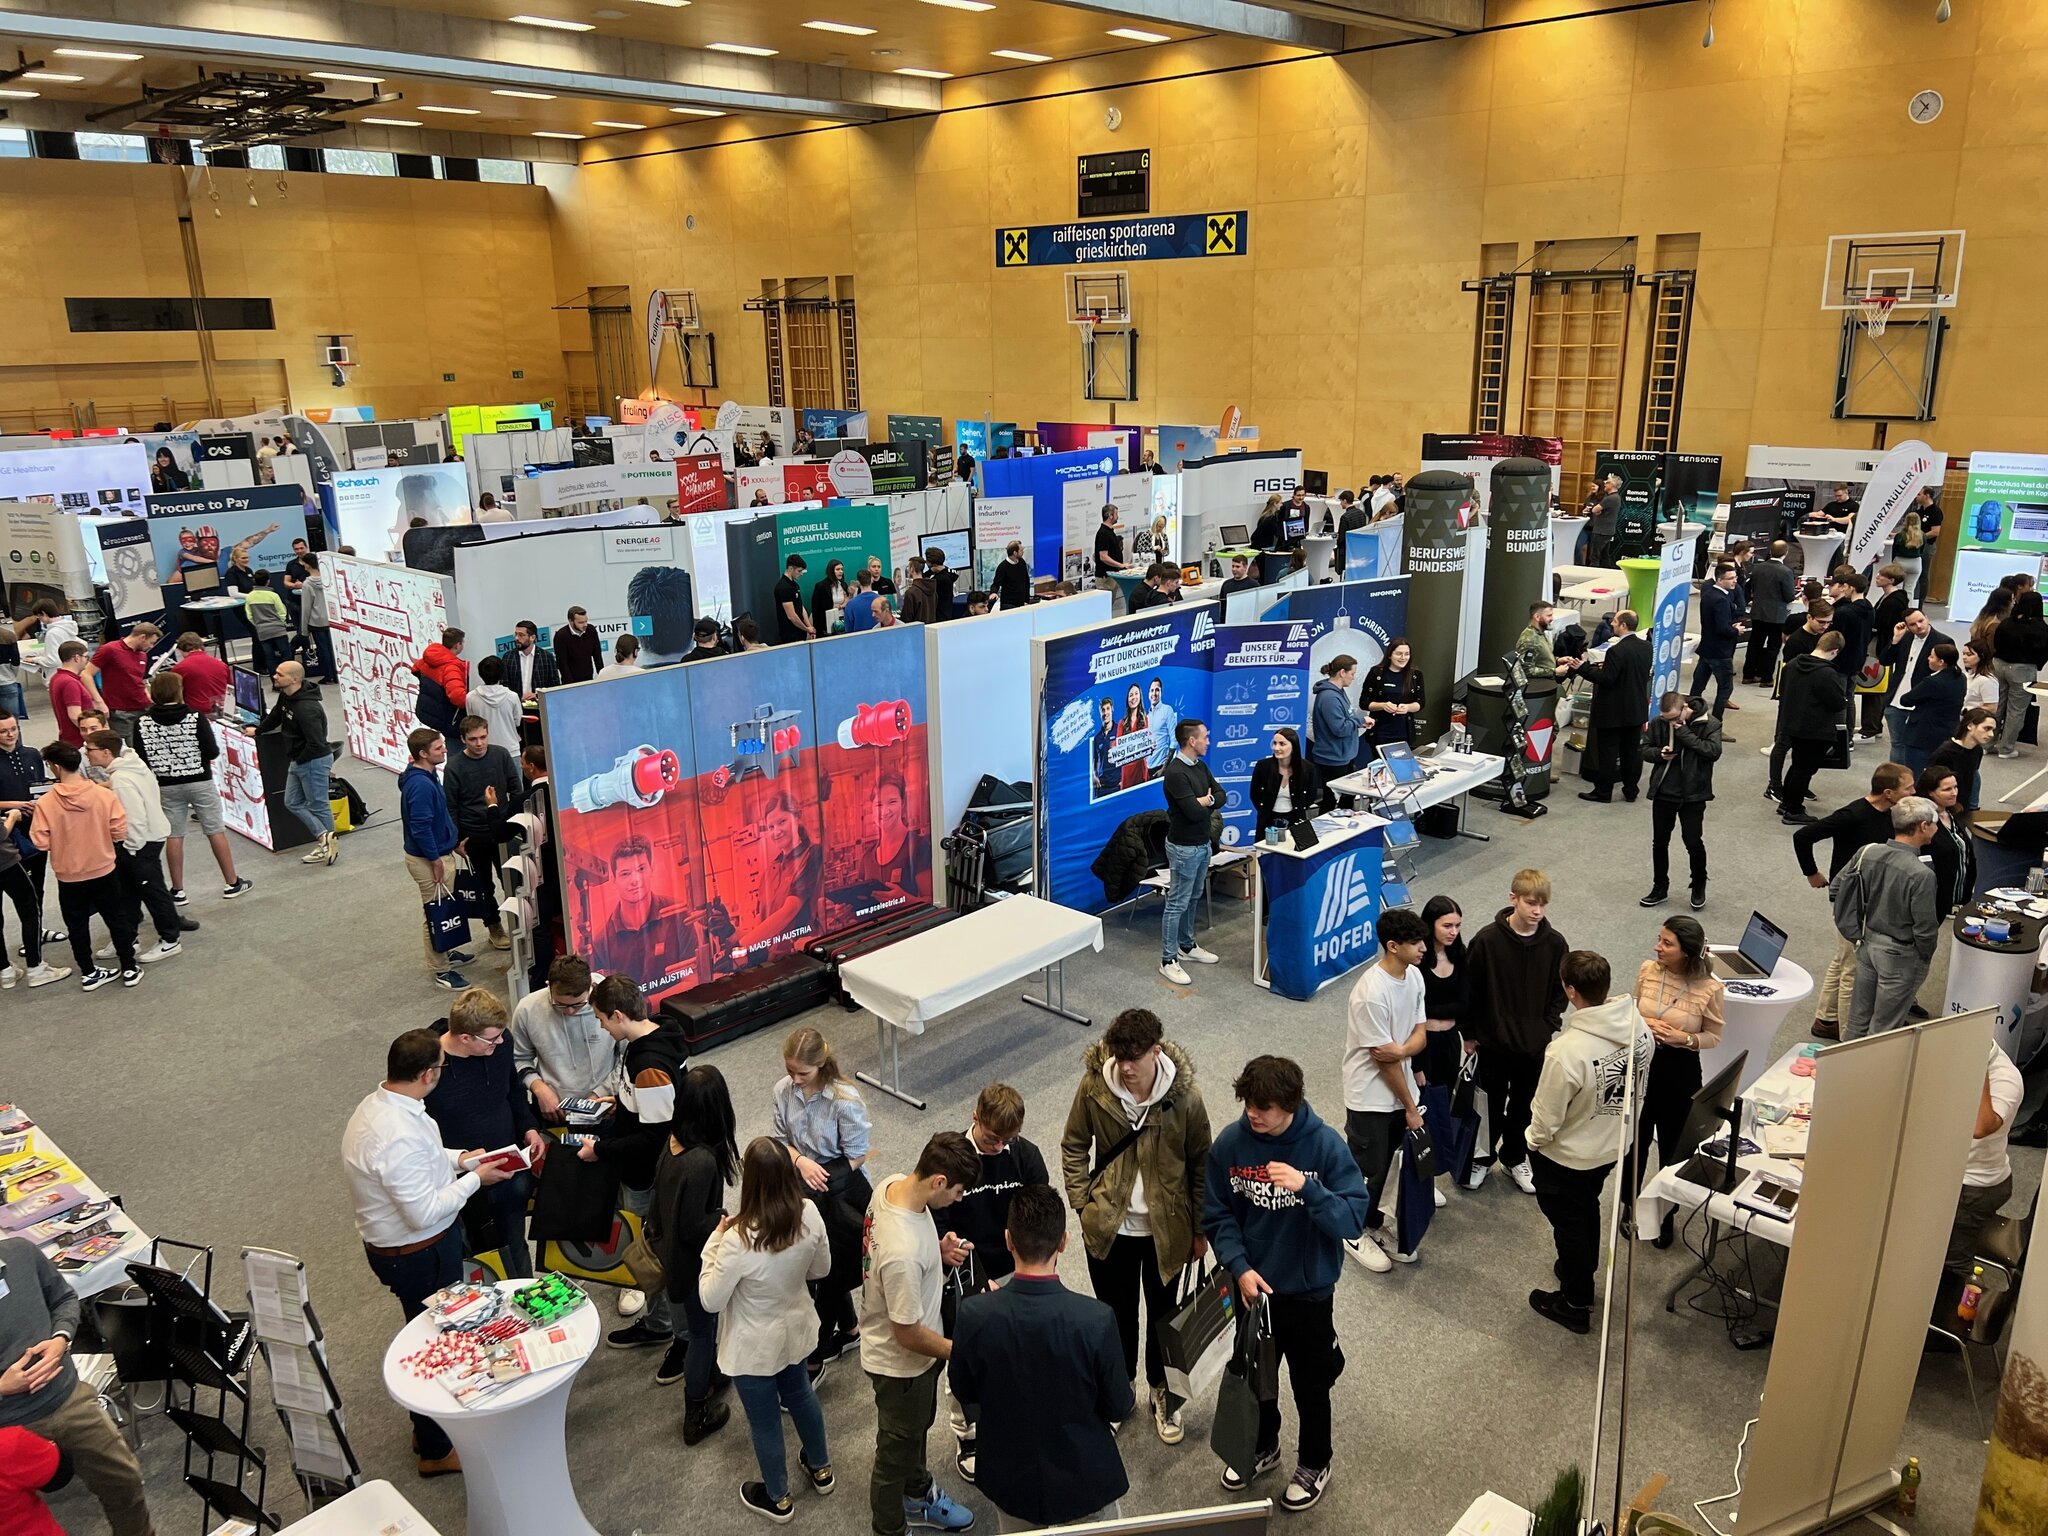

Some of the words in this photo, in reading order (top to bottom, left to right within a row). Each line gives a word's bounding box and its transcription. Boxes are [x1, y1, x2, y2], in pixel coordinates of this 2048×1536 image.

[1080, 160, 1087, 174] H
[1141, 153, 1149, 168] G
[1053, 226, 1106, 244] raiffeisen
[1109, 222, 1175, 243] sportarena
[1075, 242, 1147, 263] grieskirchen
[497, 423, 531, 431] CONSULTING
[208, 446, 232, 456] CAS
[1613, 453, 1656, 461] SENSONIC
[1679, 455, 1719, 464] SENSONIC
[13, 464, 55, 474] Healthcare
[1055, 463, 1098, 475] MICROLAB
[336, 477, 380, 489] scheuch
[893, 482, 916, 491] DEINEN
[1254, 478, 1296, 492] AGS
[151, 502, 204, 515] Procure
[208, 500, 223, 510] to
[226, 497, 250, 510] Pay
[1855, 471, 1915, 553] SCHWARZMÜLLER
[783, 522, 829, 536] INDIVIDUELLE
[616, 537, 649, 545] ENERGIE
[649, 536, 660, 544] AG
[783, 530, 862, 546] IT-GESAMTLÖSUNGEN
[1370, 588, 1402, 598] INFONIQA
[378, 612, 406, 630] FUTURE
[1190, 638, 1216, 653] HOFER
[1245, 642, 1278, 652] UNSERE
[1286, 641, 1309, 649] HOFER
[1095, 653, 1115, 669] JETZT
[1117, 640, 1174, 662] DURCHSTARTEN
[1229, 653, 1267, 664] BENEFITS
[1268, 652, 1285, 663] FÜR
[1099, 671, 1107, 680] IM
[1108, 666, 1128, 678] NEUEN
[1128, 656, 1159, 672] TRAUMJOB
[1117, 737, 1127, 746] Der
[1127, 731, 1149, 742] richtige
[1111, 748, 1126, 759] Weg
[1126, 743, 1136, 754] für
[855, 895, 906, 917] www.pcelectric.at
[441, 915, 461, 931] DIG
[749, 938, 772, 953] MADE
[773, 936, 781, 945] IN
[781, 924, 812, 943] AUSTRIA
[1314, 920, 1373, 967] HOFER
[649, 979, 659, 991] IN
[659, 967, 694, 986] AUSTRIA
[1243, 1180, 1272, 1197] LUCK
